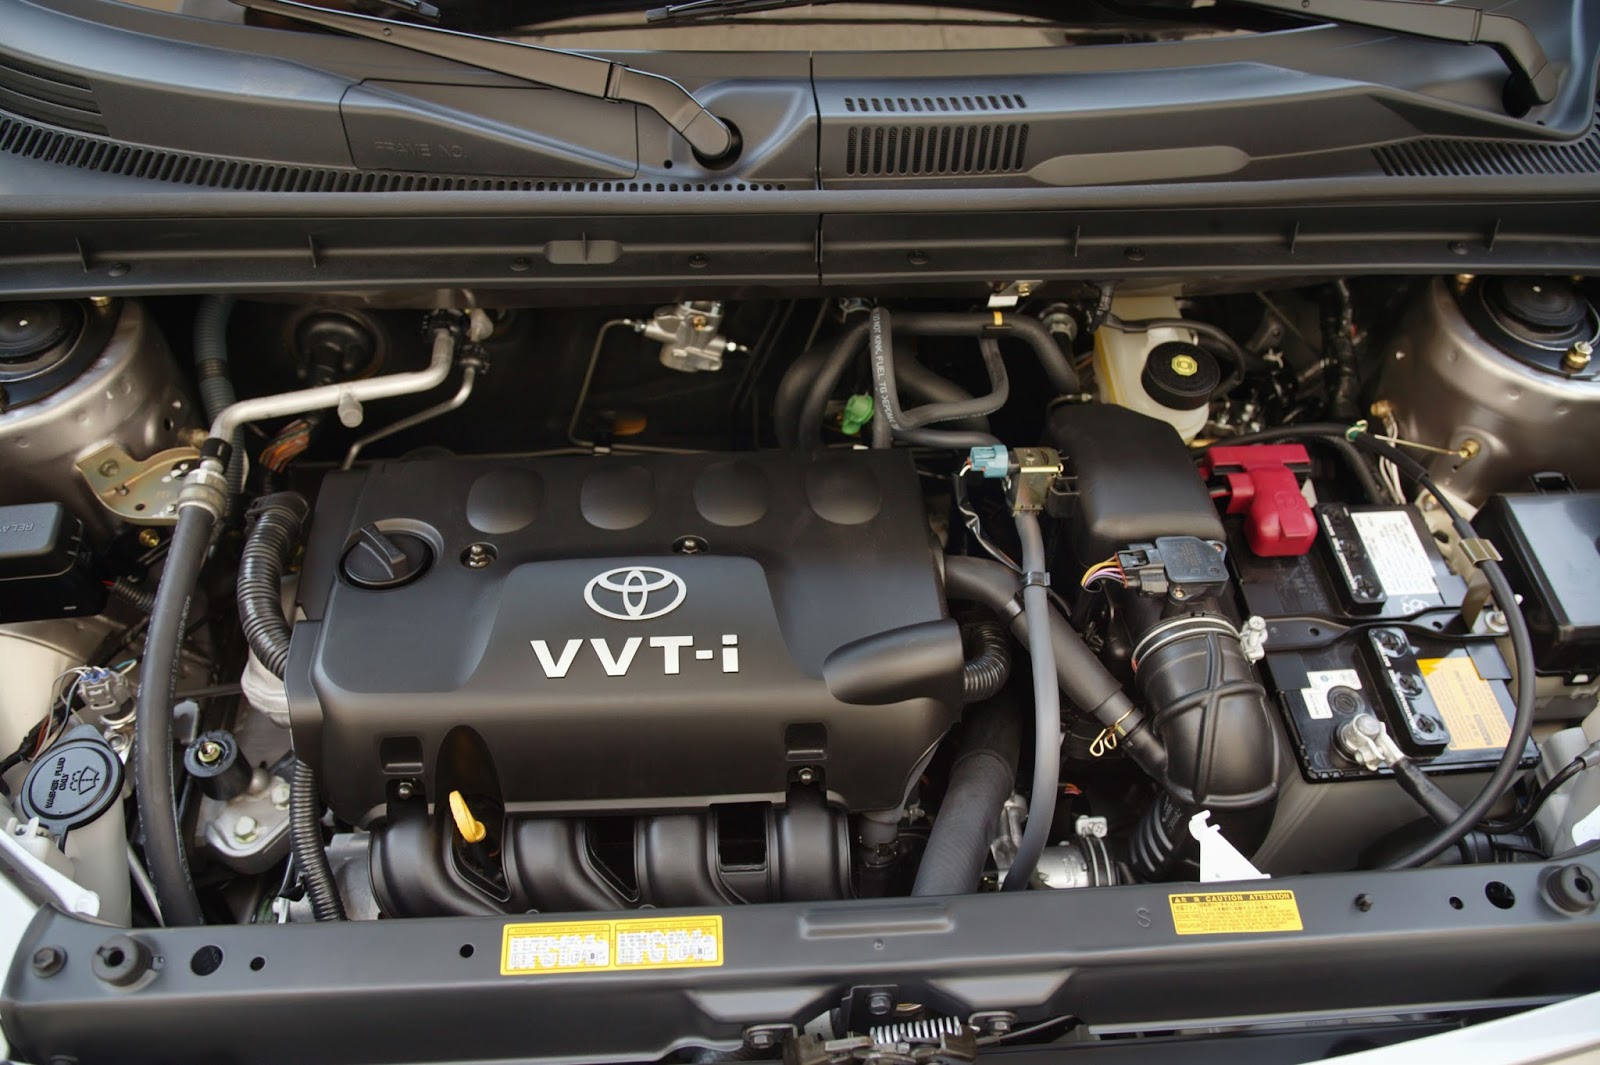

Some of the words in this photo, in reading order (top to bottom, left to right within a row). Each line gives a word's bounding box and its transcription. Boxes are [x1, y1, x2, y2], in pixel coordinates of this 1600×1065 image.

[873, 320, 881, 334] NOT
[876, 355, 885, 380] FUEL
[879, 381, 888, 394] TG
[0, 523, 34, 533] RELA
[530, 634, 739, 678] VVT-i
[45, 779, 60, 809] WASHER
[54, 757, 66, 776] FLUID
[59, 773, 69, 791] ONLY
[1205, 894, 1244, 903] CAUTION
[1249, 892, 1290, 901] ATTENTION
